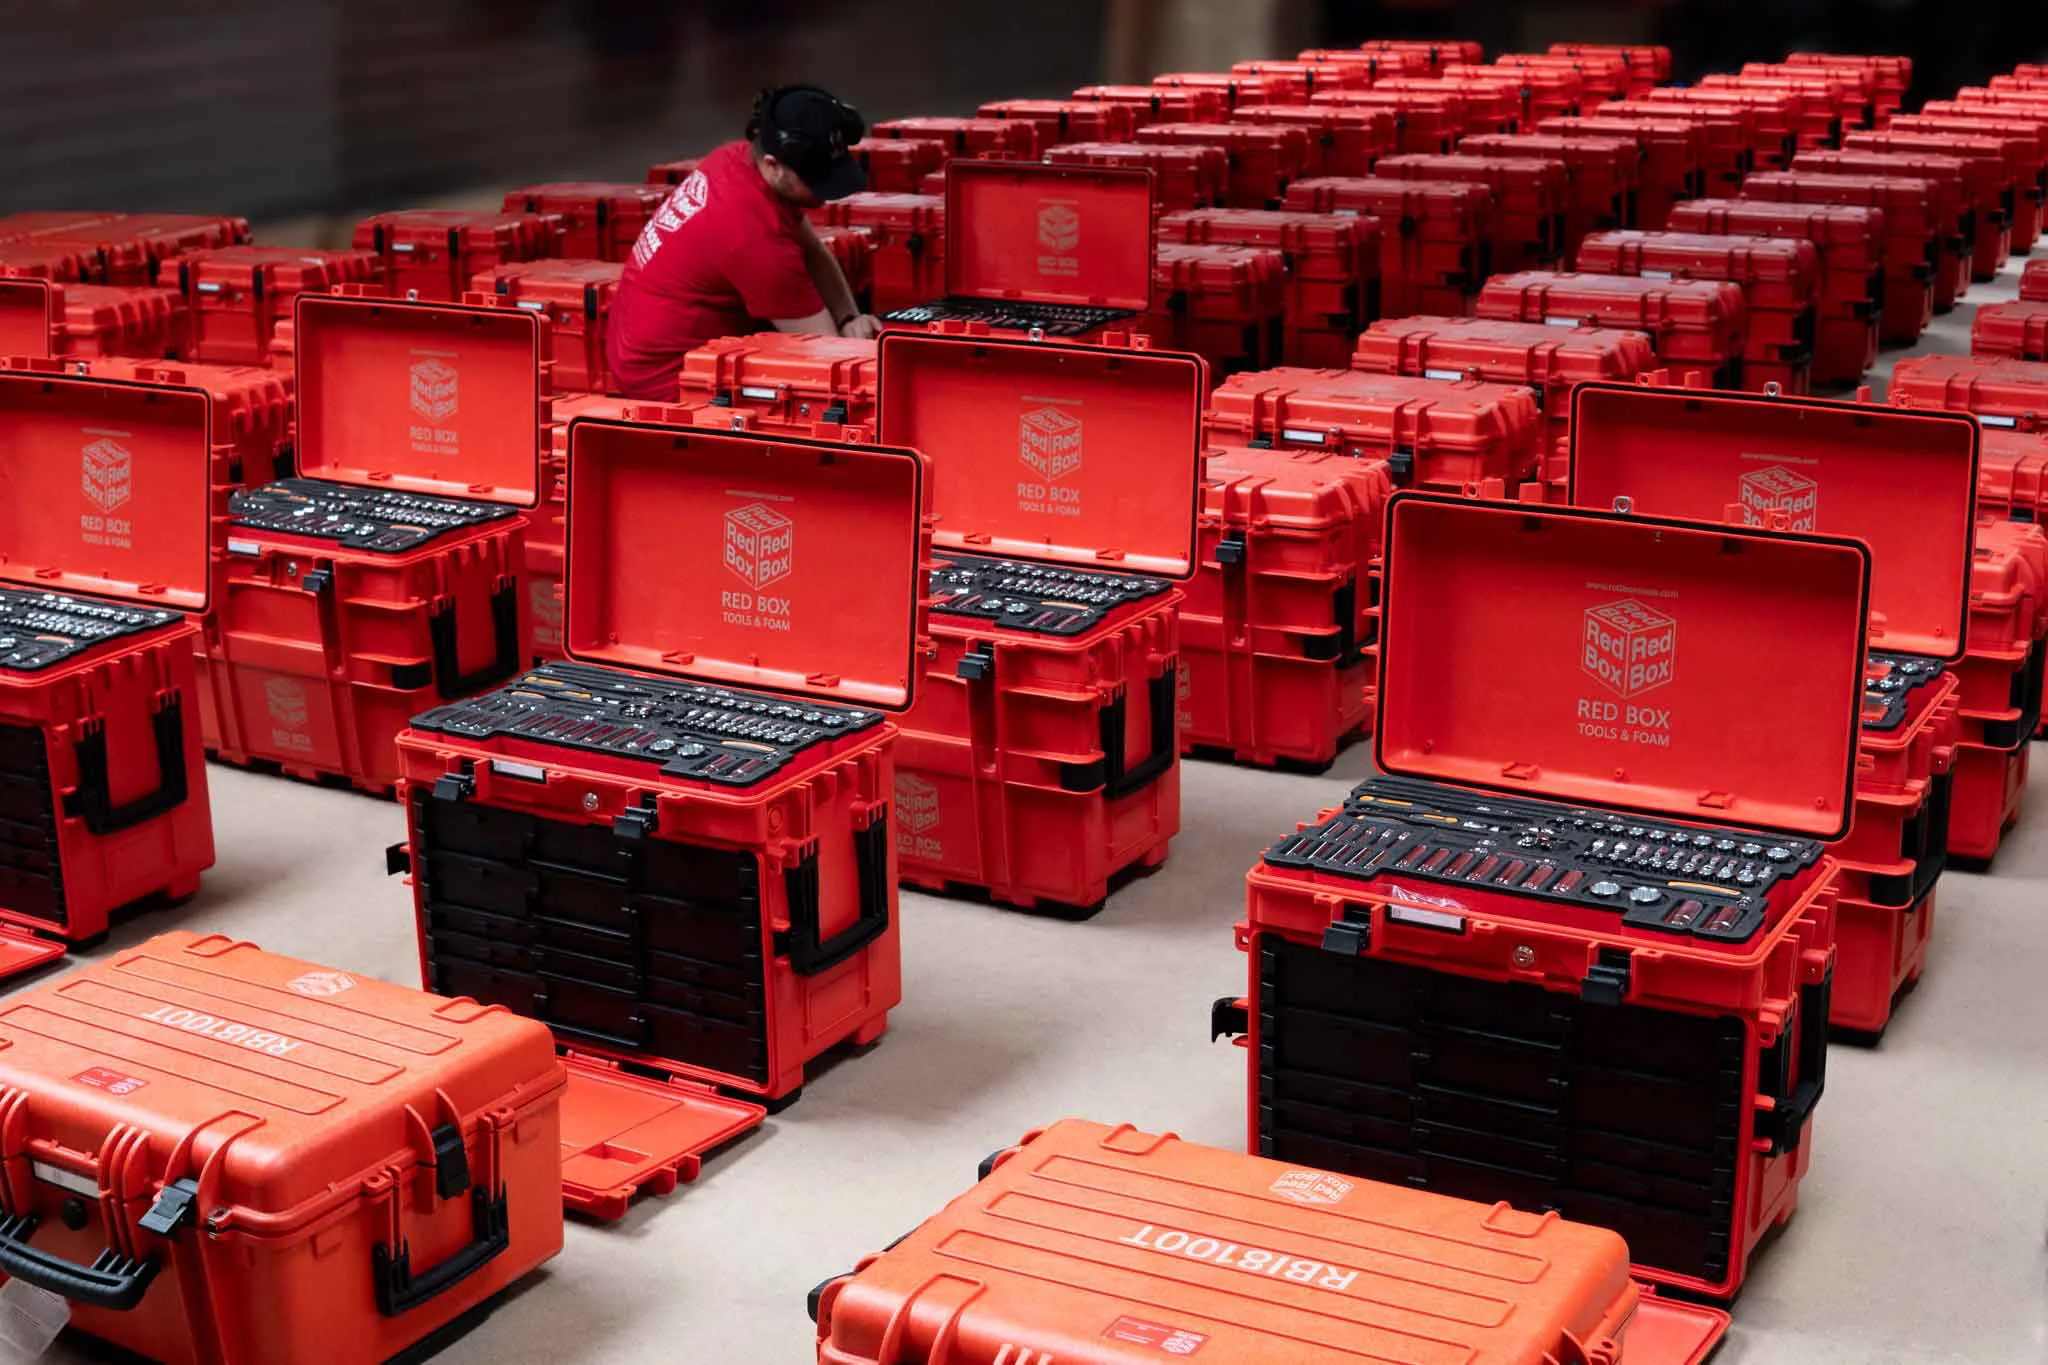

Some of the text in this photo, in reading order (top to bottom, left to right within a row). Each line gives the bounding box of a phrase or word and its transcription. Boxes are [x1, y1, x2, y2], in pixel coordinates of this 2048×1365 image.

[1017, 482, 1080, 503] RED BOX
[81, 514, 132, 535] RED BOX
[727, 521, 755, 557] Red
[760, 527, 789, 560] Red
[727, 543, 753, 582] Box
[759, 555, 789, 582] Box
[721, 591, 790, 616] RED BOX
[722, 611, 791, 633] TOOLS & FOAM
[1587, 617, 1624, 660] Red
[1631, 627, 1672, 662] Red
[1585, 643, 1621, 688] Box
[1630, 659, 1669, 689] Box
[1577, 698, 1671, 729] RED BOX
[1577, 721, 1670, 747] TOOLS & FOAM
[916, 836, 941, 851] BOX
